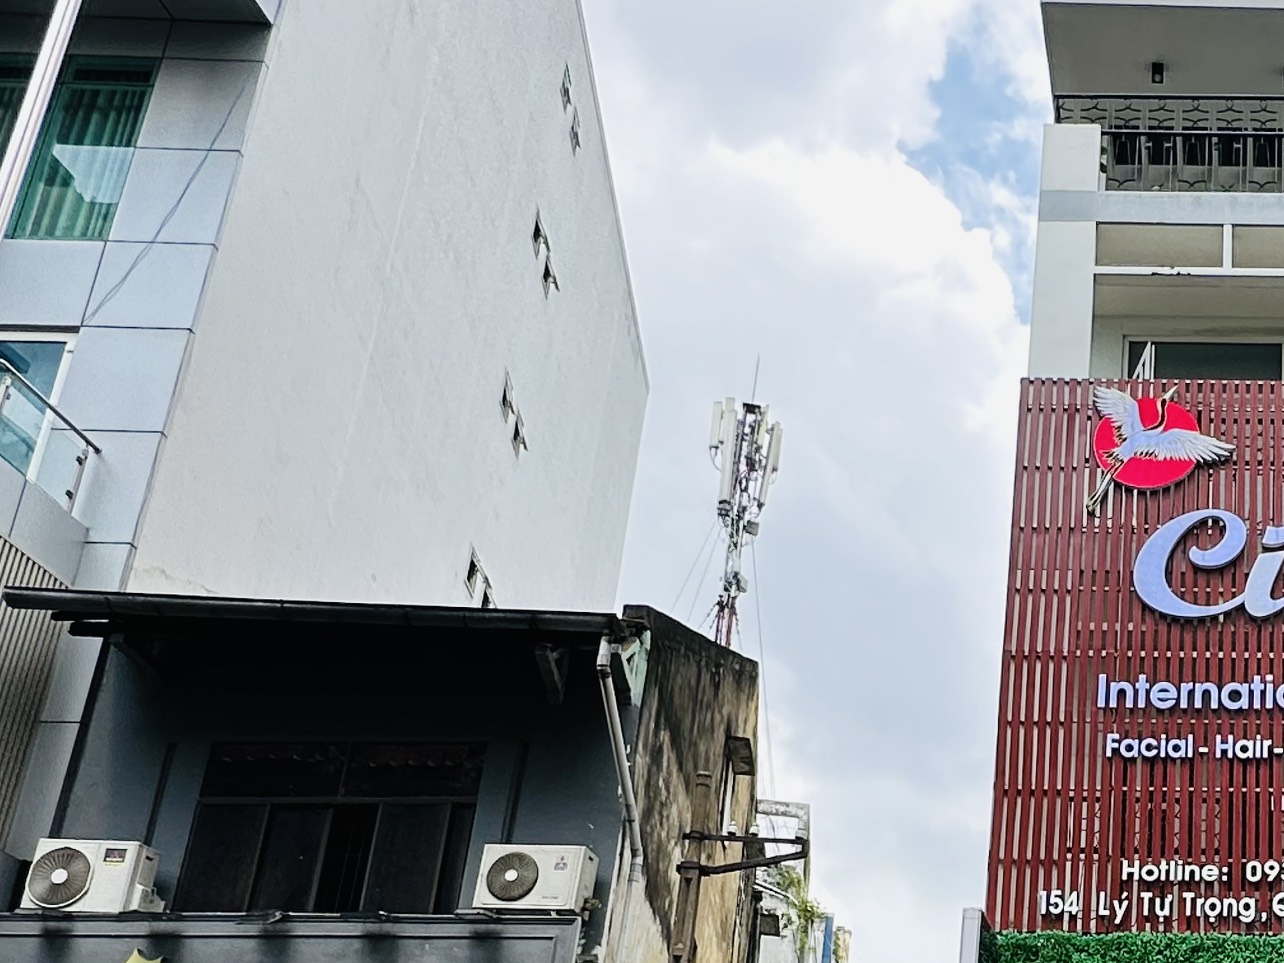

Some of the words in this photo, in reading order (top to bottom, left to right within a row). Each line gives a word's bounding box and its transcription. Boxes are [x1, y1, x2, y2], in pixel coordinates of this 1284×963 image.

[1121, 859, 1229, 883] Hotline:
[1038, 889, 1079, 916] 154
[1098, 889, 1128, 924] Lý
[1140, 891, 1172, 924] Tự
